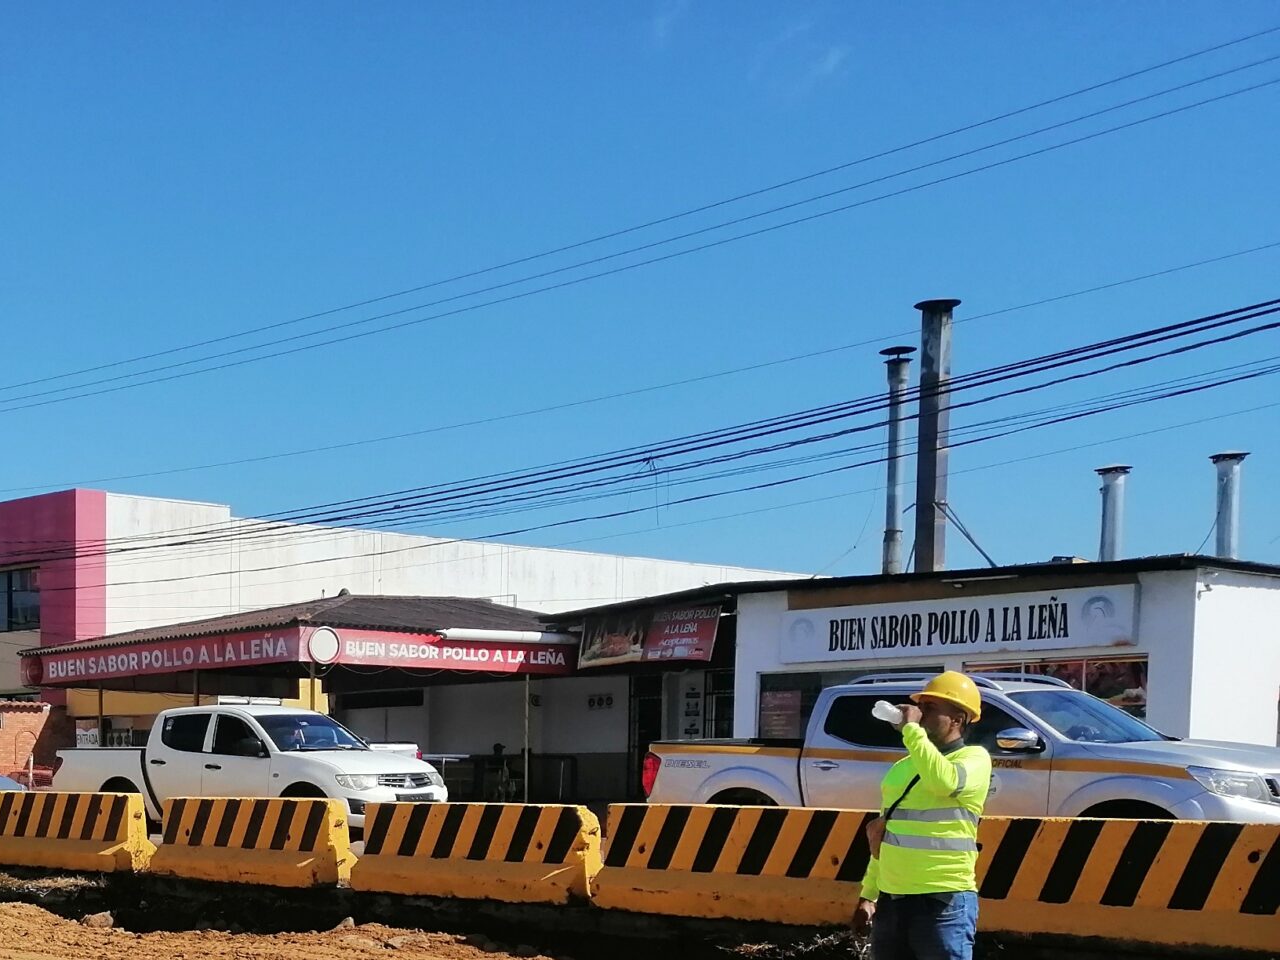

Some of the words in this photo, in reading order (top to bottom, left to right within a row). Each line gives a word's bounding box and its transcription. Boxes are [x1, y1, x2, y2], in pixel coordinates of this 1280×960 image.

[672, 610, 694, 621] SABOR
[694, 608, 717, 619] POLLO
[670, 624, 680, 634] LA
[828, 617, 866, 652] BUEN
[870, 613, 921, 649] SABOR
[927, 608, 980, 646] POLLO
[984, 608, 996, 643] A
[1001, 605, 1022, 642] LA
[1027, 596, 1069, 641] LEÑA
[49, 659, 85, 678] BUEN
[88, 653, 138, 674] SABOR
[142, 645, 194, 668] POLLO
[198, 645, 210, 664] A
[214, 641, 236, 662] LA
[240, 633, 288, 660] LEÑA
[345, 640, 386, 656] BUEN
[389, 643, 438, 660] SABOR
[442, 647, 489, 663] POLLO
[493, 650, 504, 663] A
[507, 650, 526, 664] LA
[530, 648, 566, 666] LEÑA
[665, 759, 710, 769] DIESEL
[992, 759, 1023, 769] OFICIAL
